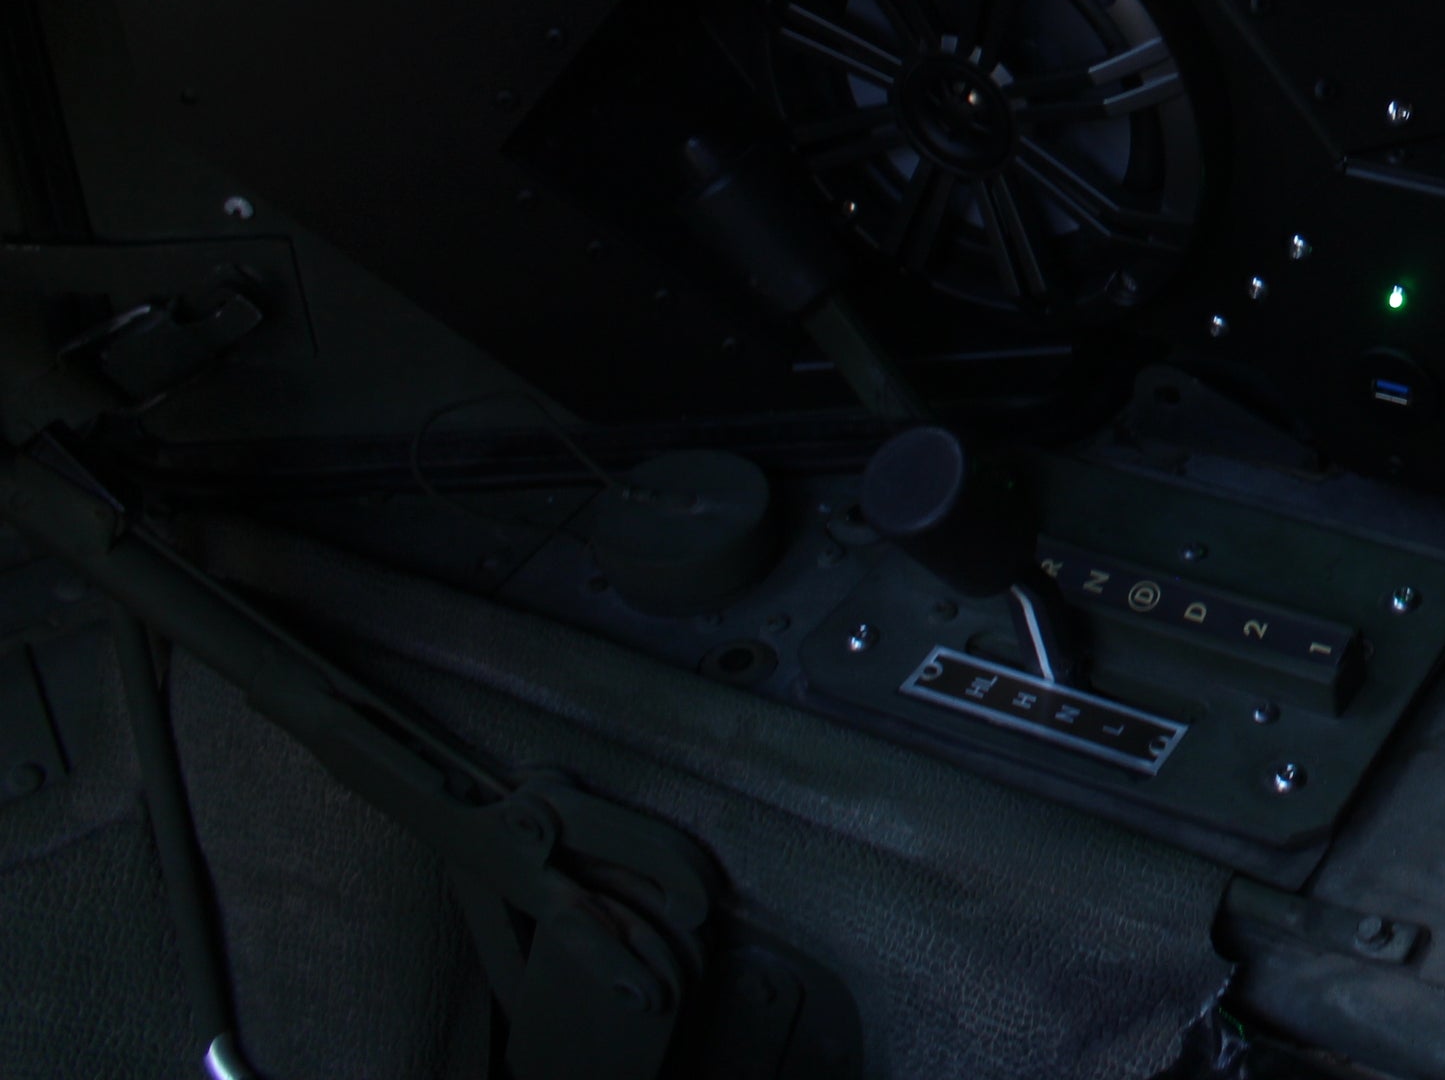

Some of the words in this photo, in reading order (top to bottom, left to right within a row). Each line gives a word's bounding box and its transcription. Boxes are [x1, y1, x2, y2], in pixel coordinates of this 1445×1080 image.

[1040, 558, 1064, 579] R
[1082, 568, 1110, 595] N
[1183, 602, 1207, 623] D
[1243, 619, 1268, 640] 2
[1309, 641, 1332, 656] 1
[1011, 691, 1037, 710] H
[1055, 704, 1081, 724] N
[1101, 723, 1125, 737] L
